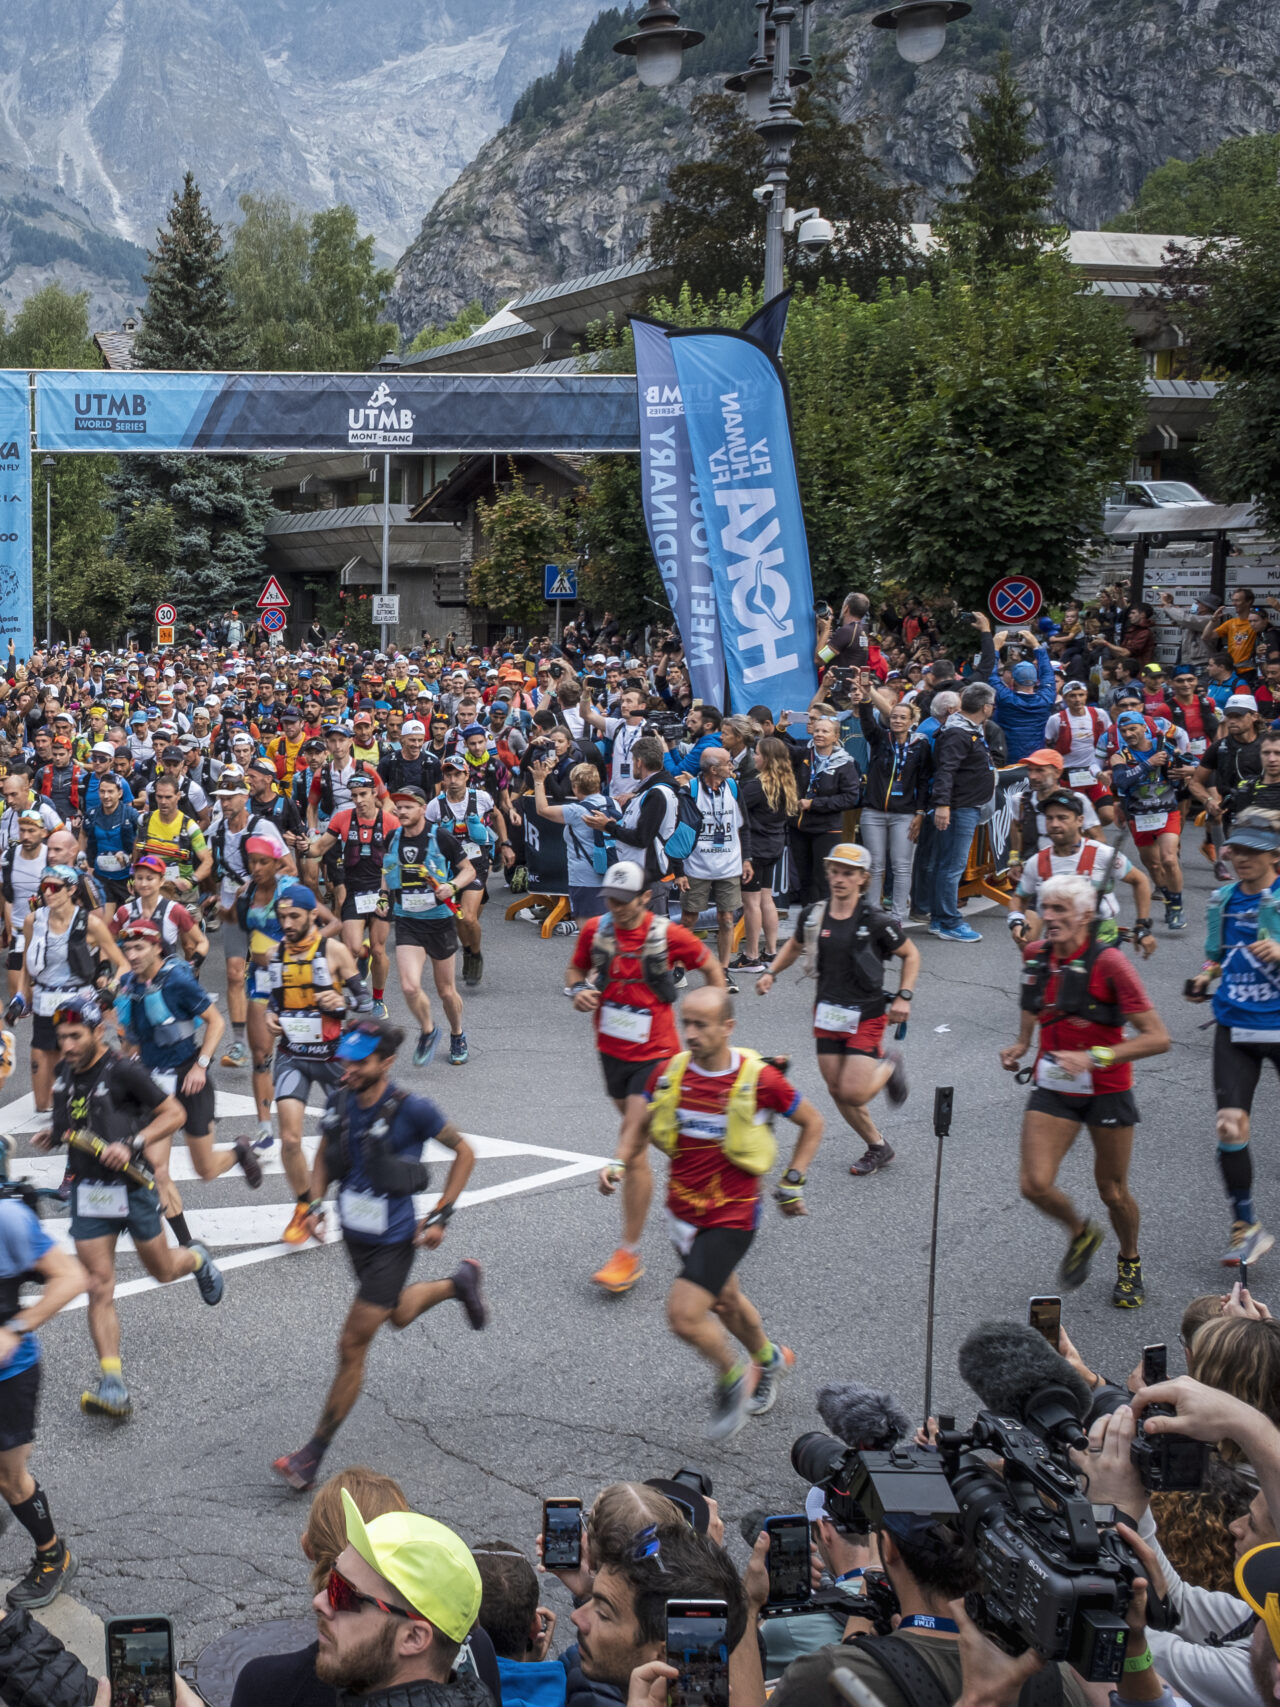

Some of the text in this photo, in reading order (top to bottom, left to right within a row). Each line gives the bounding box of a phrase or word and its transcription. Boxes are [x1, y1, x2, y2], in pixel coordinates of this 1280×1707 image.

[74, 393, 147, 416] UTMB
[348, 408, 414, 430] UTMB
[77, 420, 145, 431] WORLD SERIES
[351, 433, 411, 442] MONT-BLANC
[7, 464, 20, 472] FLY
[160, 609, 172, 621] 30
[1028, 1559, 1049, 1580] SONY
